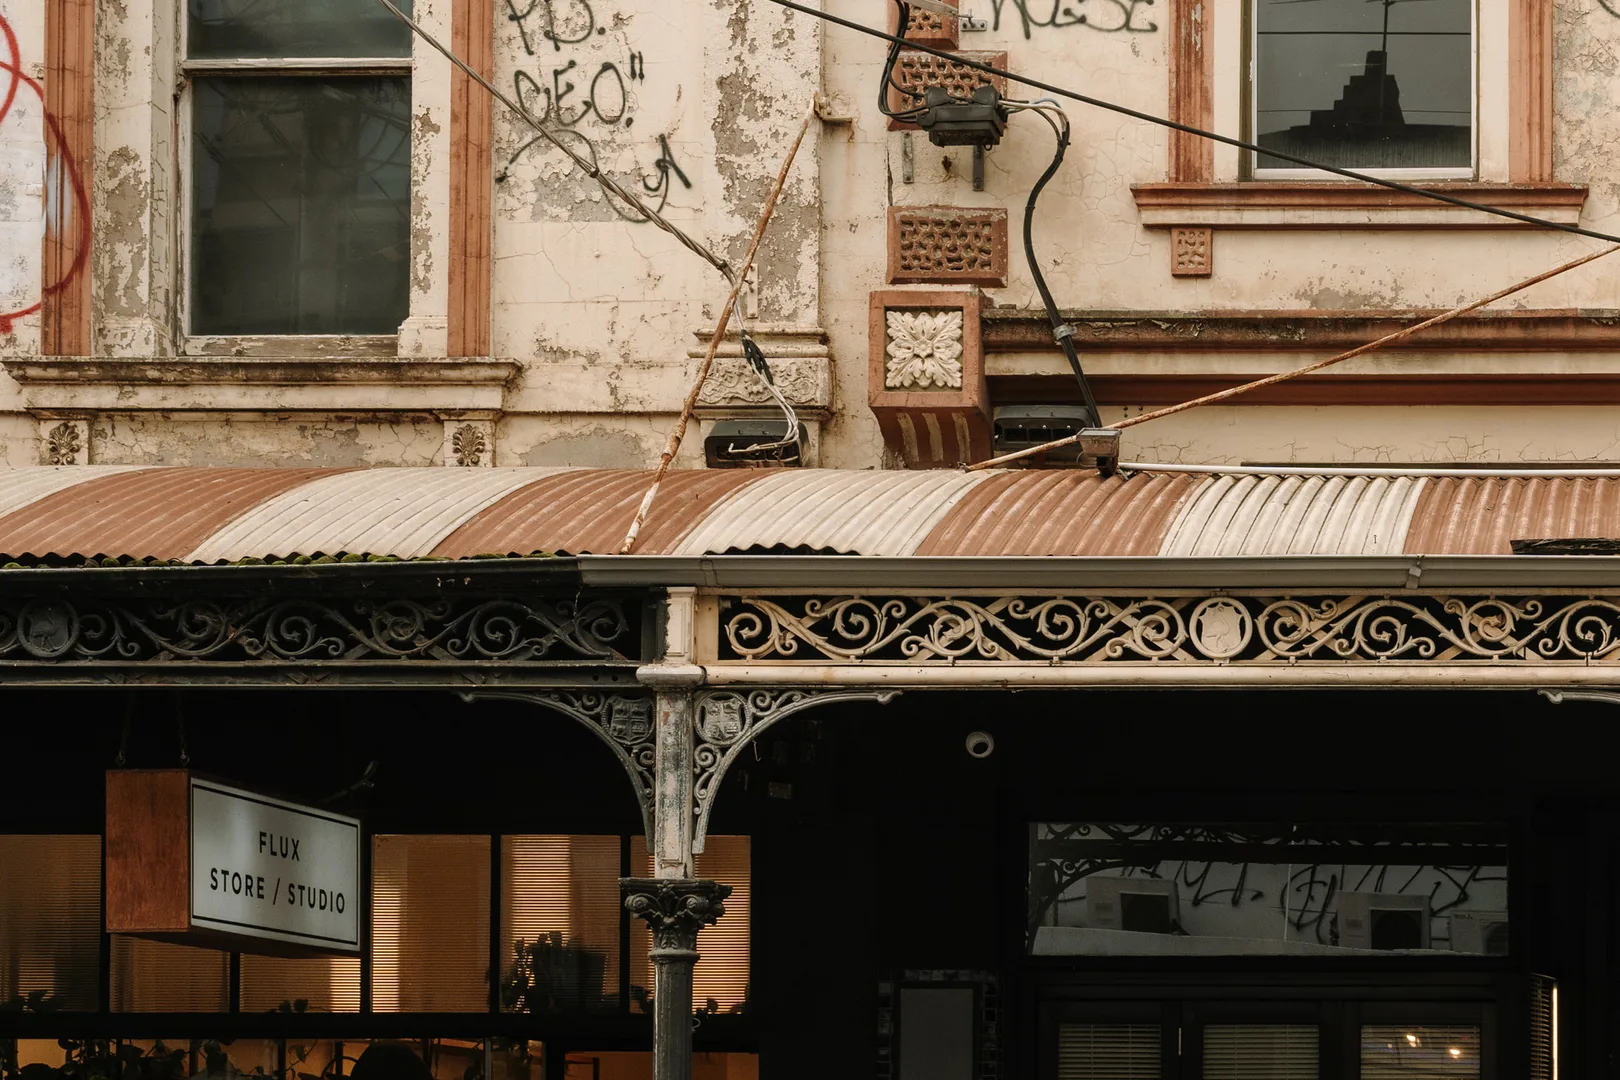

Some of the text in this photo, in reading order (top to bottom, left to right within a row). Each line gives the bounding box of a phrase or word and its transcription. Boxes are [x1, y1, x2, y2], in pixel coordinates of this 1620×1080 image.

[259, 831, 300, 861] FLUX
[210, 867, 345, 914] STORE / STUDIO
